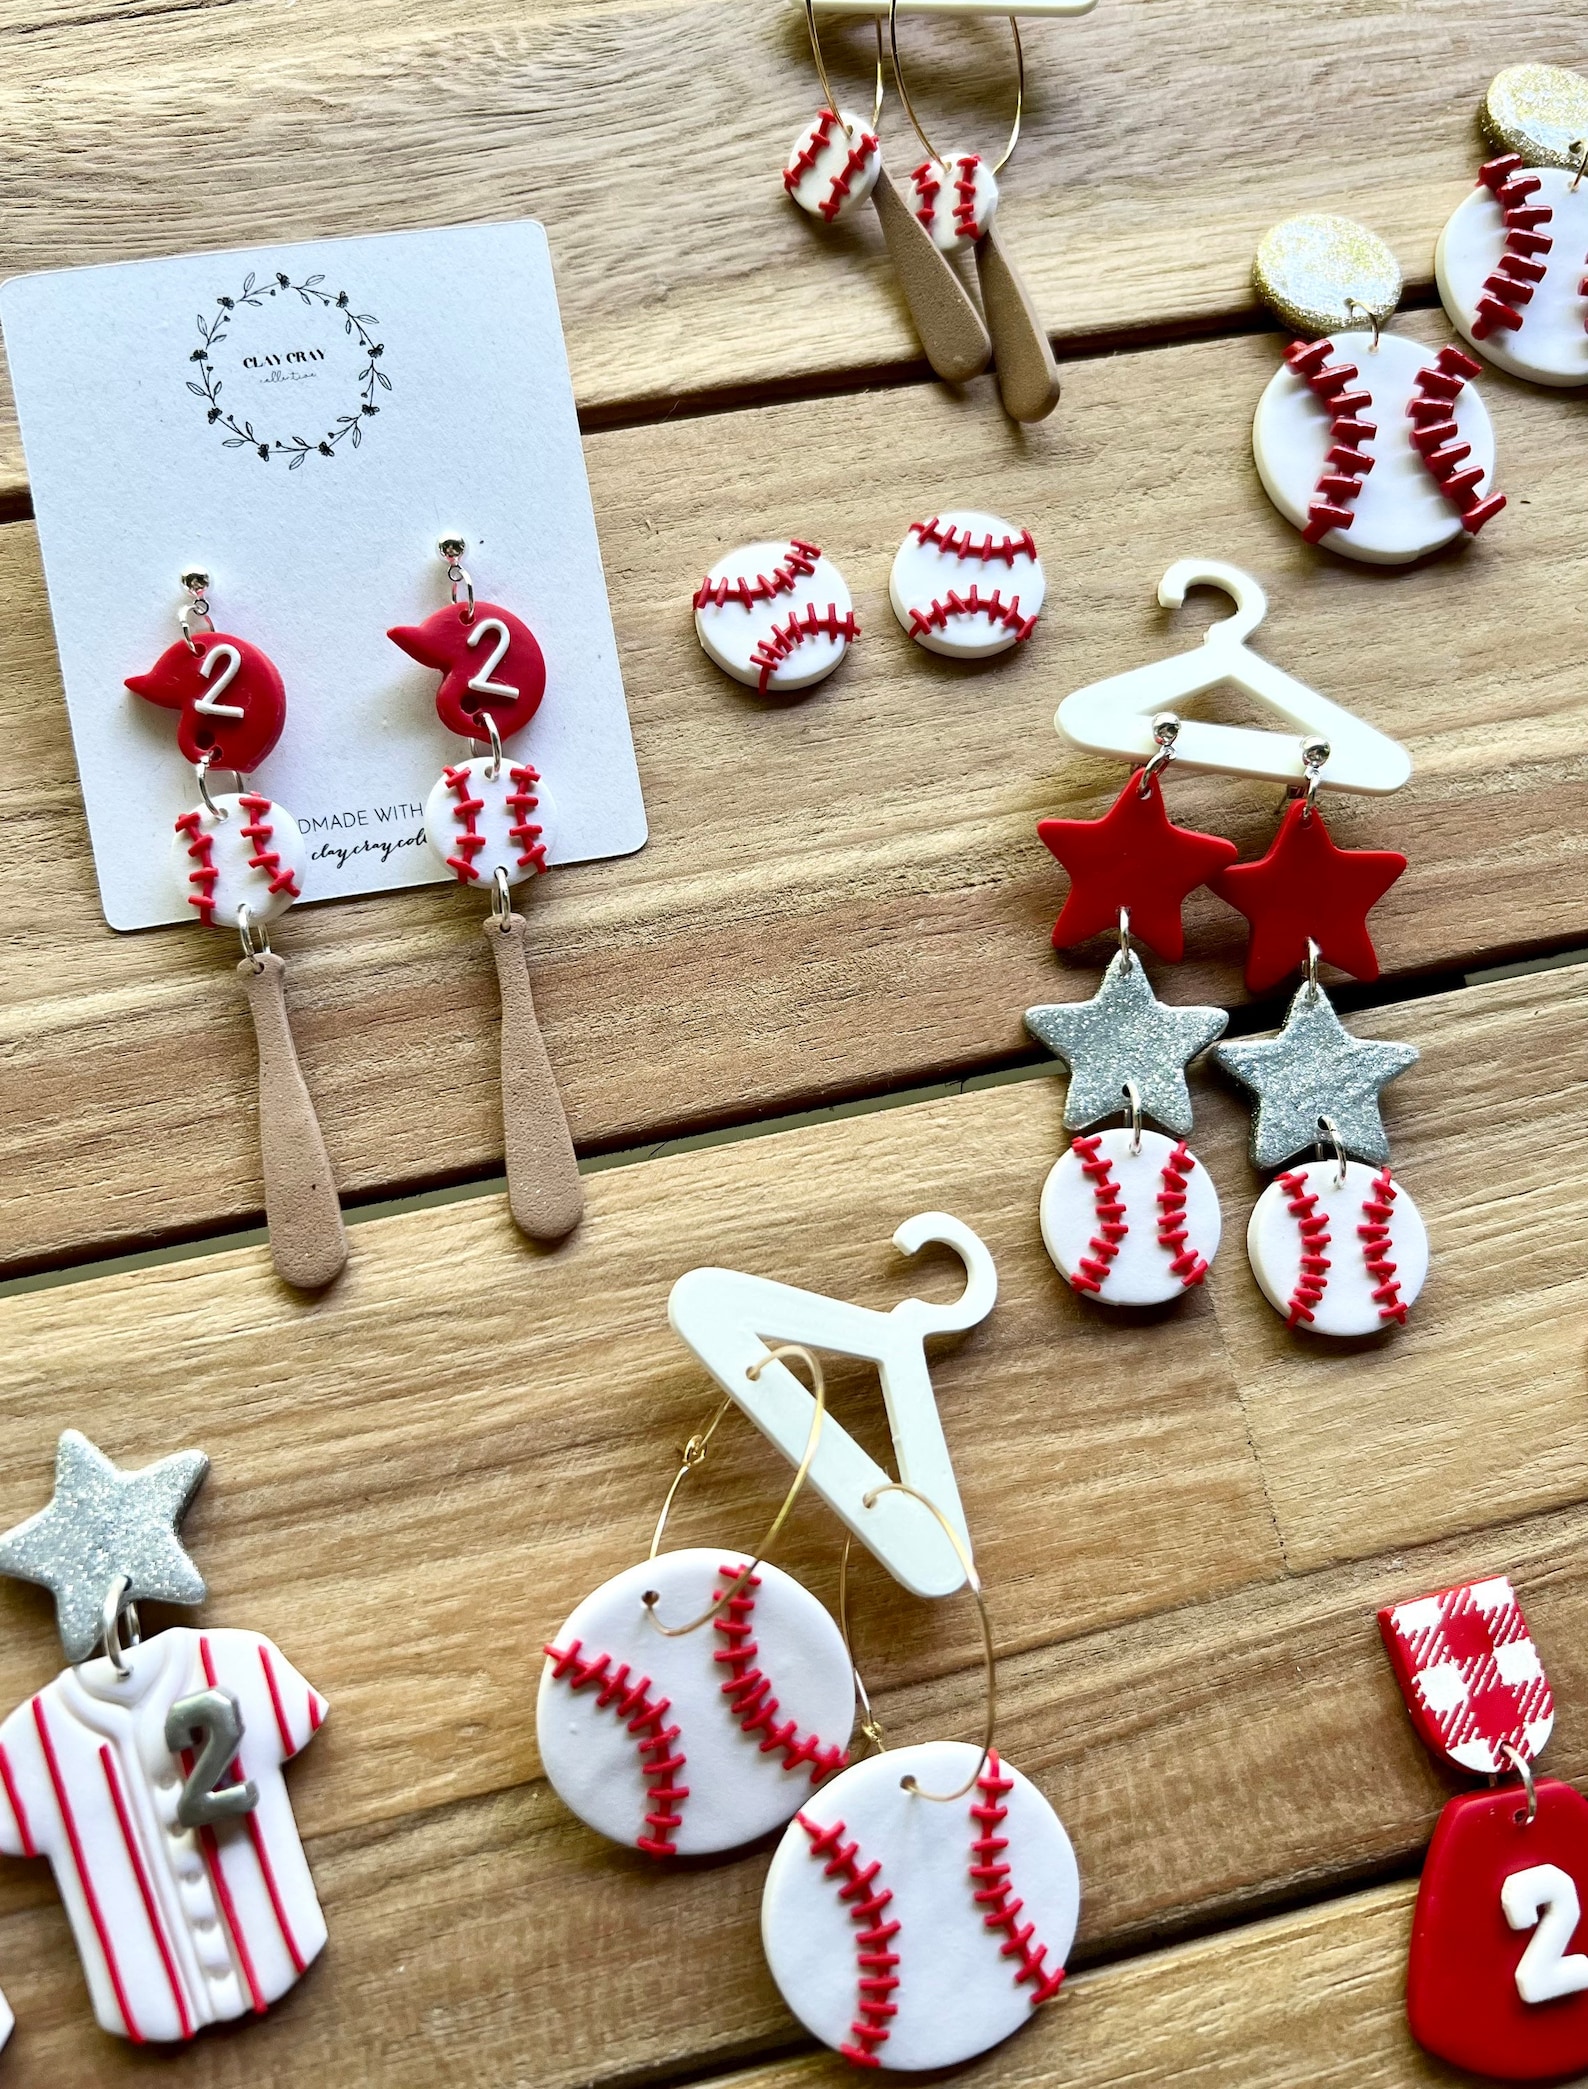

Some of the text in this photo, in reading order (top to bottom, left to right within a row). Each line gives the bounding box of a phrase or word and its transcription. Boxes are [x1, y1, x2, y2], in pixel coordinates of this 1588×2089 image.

[242, 349, 326, 369] CLAY CRAY
[194, 643, 245, 719] 2
[465, 618, 520, 700] 2
[297, 802, 424, 835] DMADE WITH
[164, 1685, 260, 1828] 2
[1501, 1863, 1588, 2004] 2
